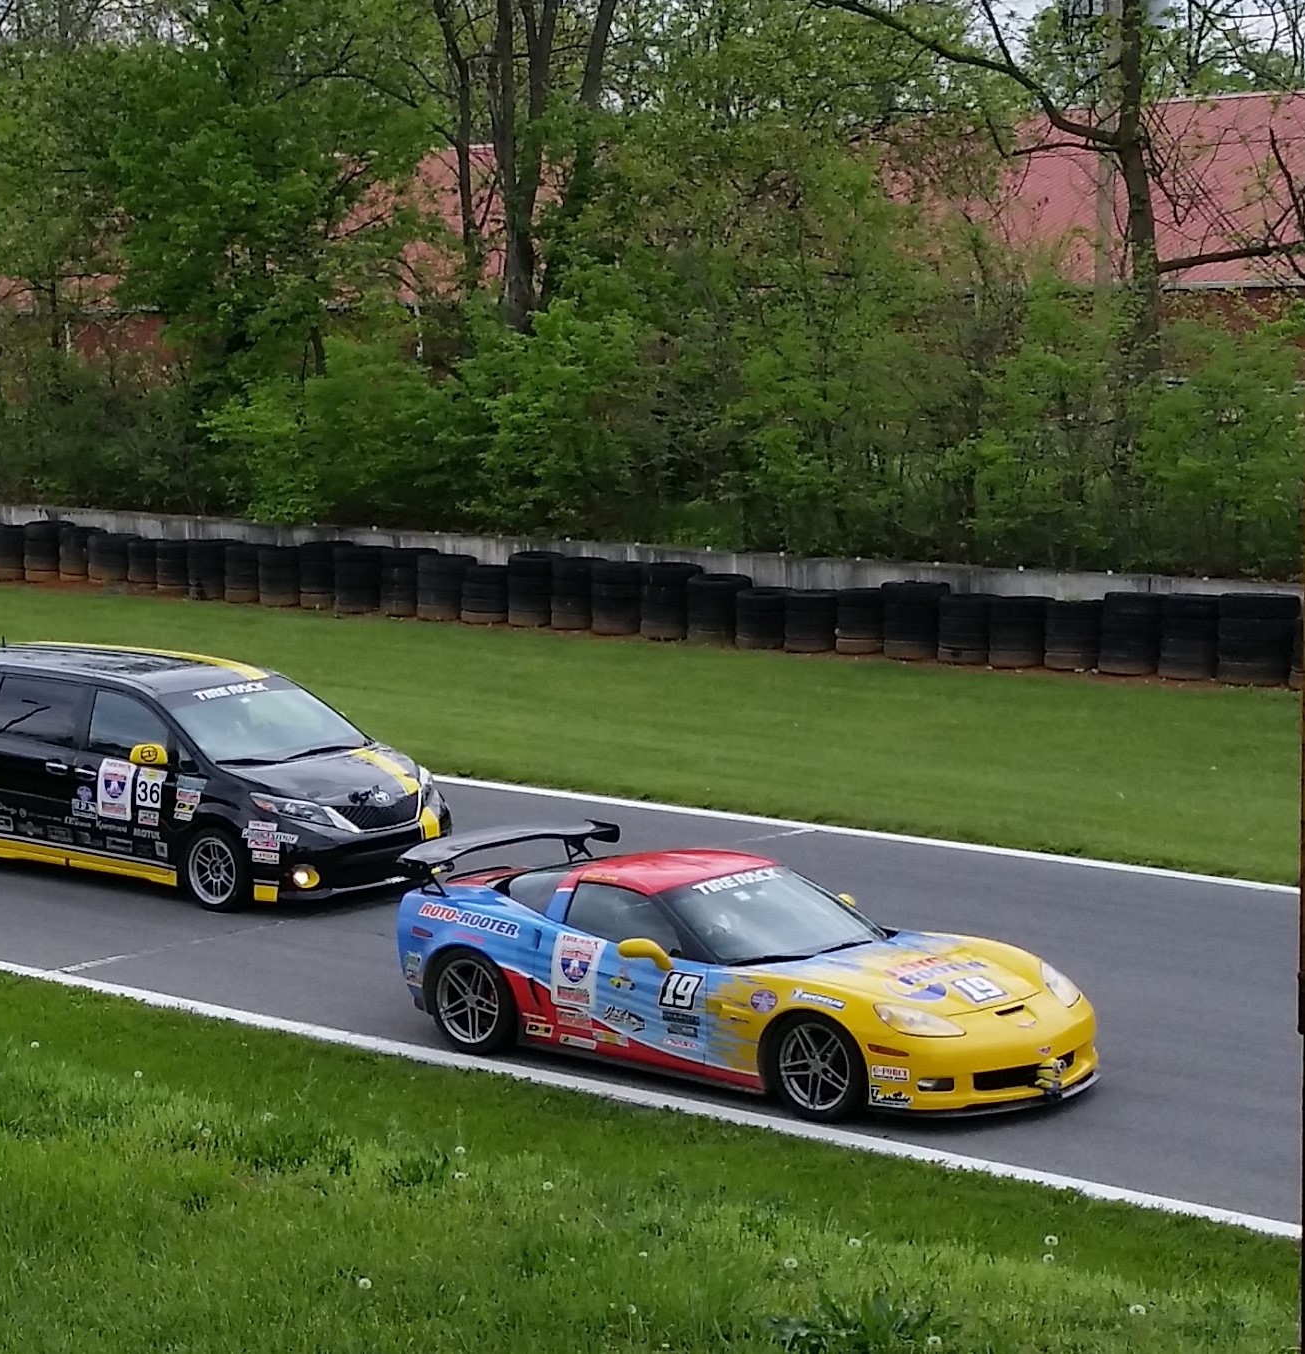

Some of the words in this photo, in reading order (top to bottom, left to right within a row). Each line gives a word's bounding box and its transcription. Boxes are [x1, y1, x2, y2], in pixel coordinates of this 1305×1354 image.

[193, 687, 231, 701] TIRE
[227, 682, 269, 695] RACK
[137, 781, 160, 804] 36
[691, 875, 738, 896] TIRE
[735, 868, 783, 886] RACK
[419, 902, 519, 937] ROTO-ROOTER
[661, 973, 700, 1008] 19
[954, 975, 1004, 1002] 19
